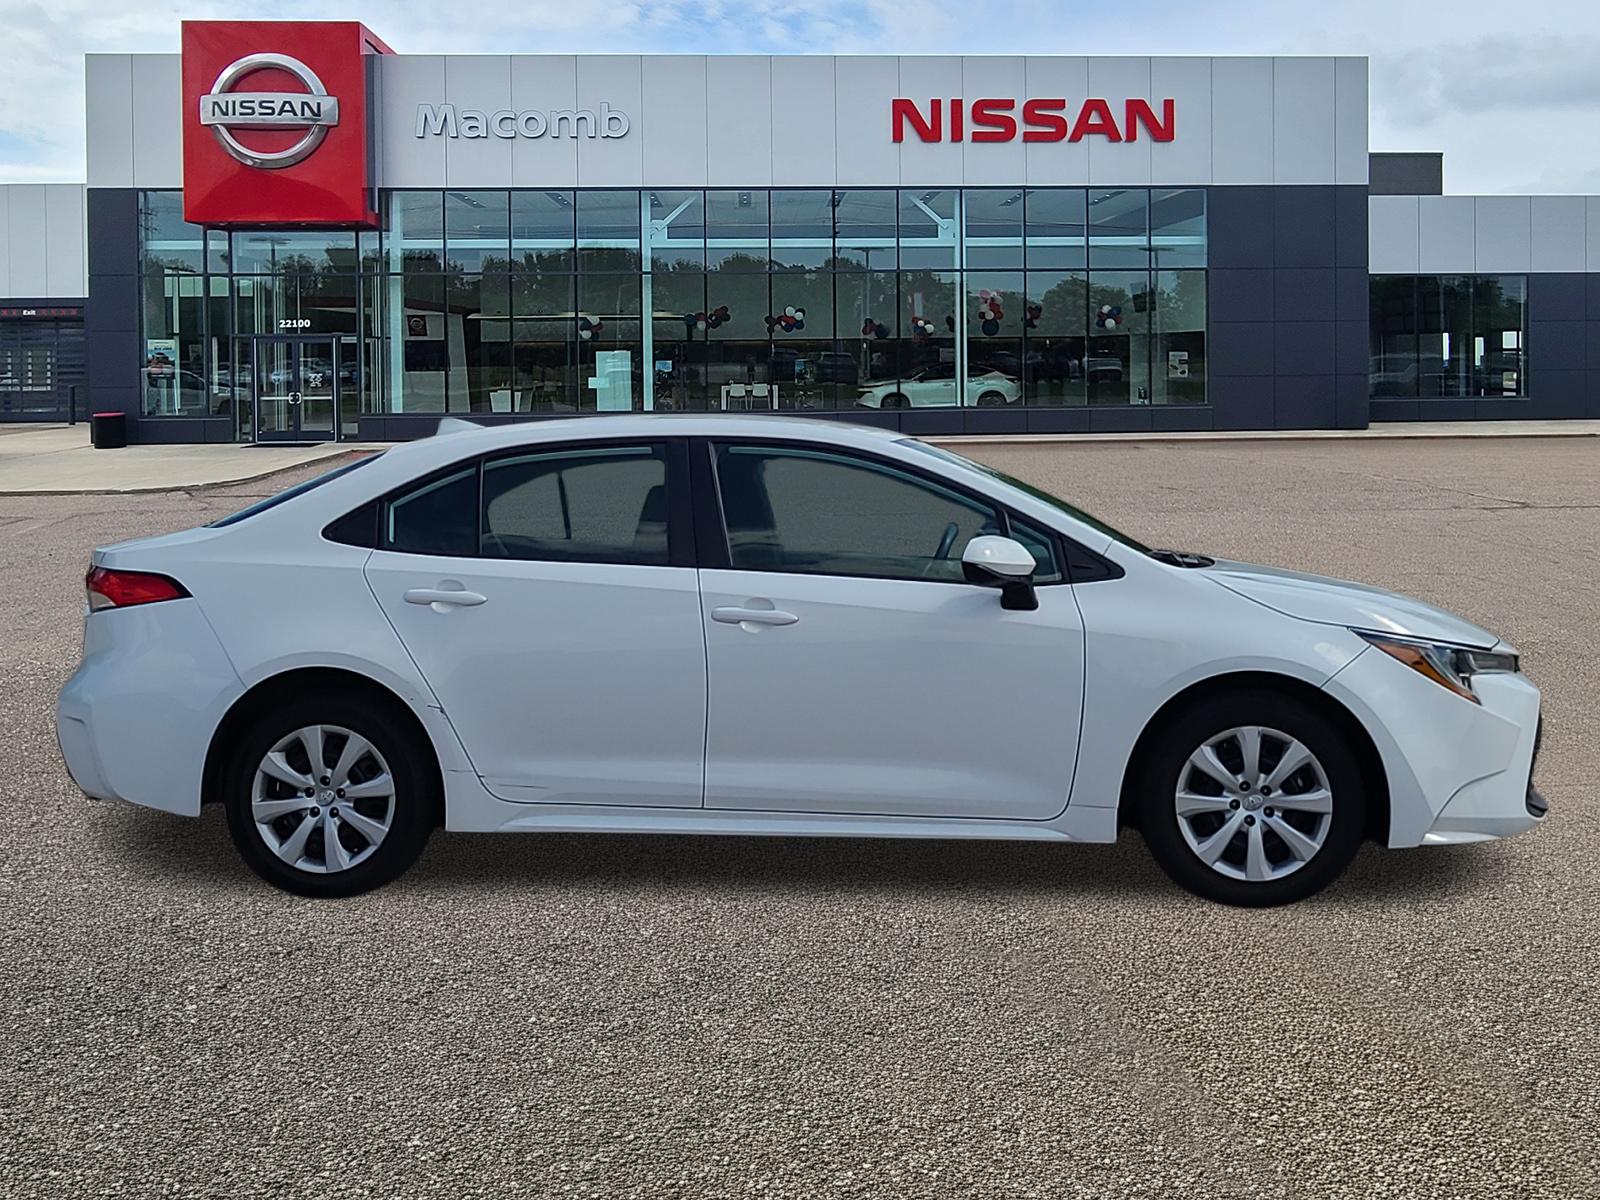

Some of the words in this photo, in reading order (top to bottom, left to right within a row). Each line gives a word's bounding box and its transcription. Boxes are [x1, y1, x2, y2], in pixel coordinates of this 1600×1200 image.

[212, 100, 322, 117] NISSAN
[415, 102, 630, 139] Macomb
[891, 98, 1175, 143] NISSAN
[279, 319, 311, 328] 22100
